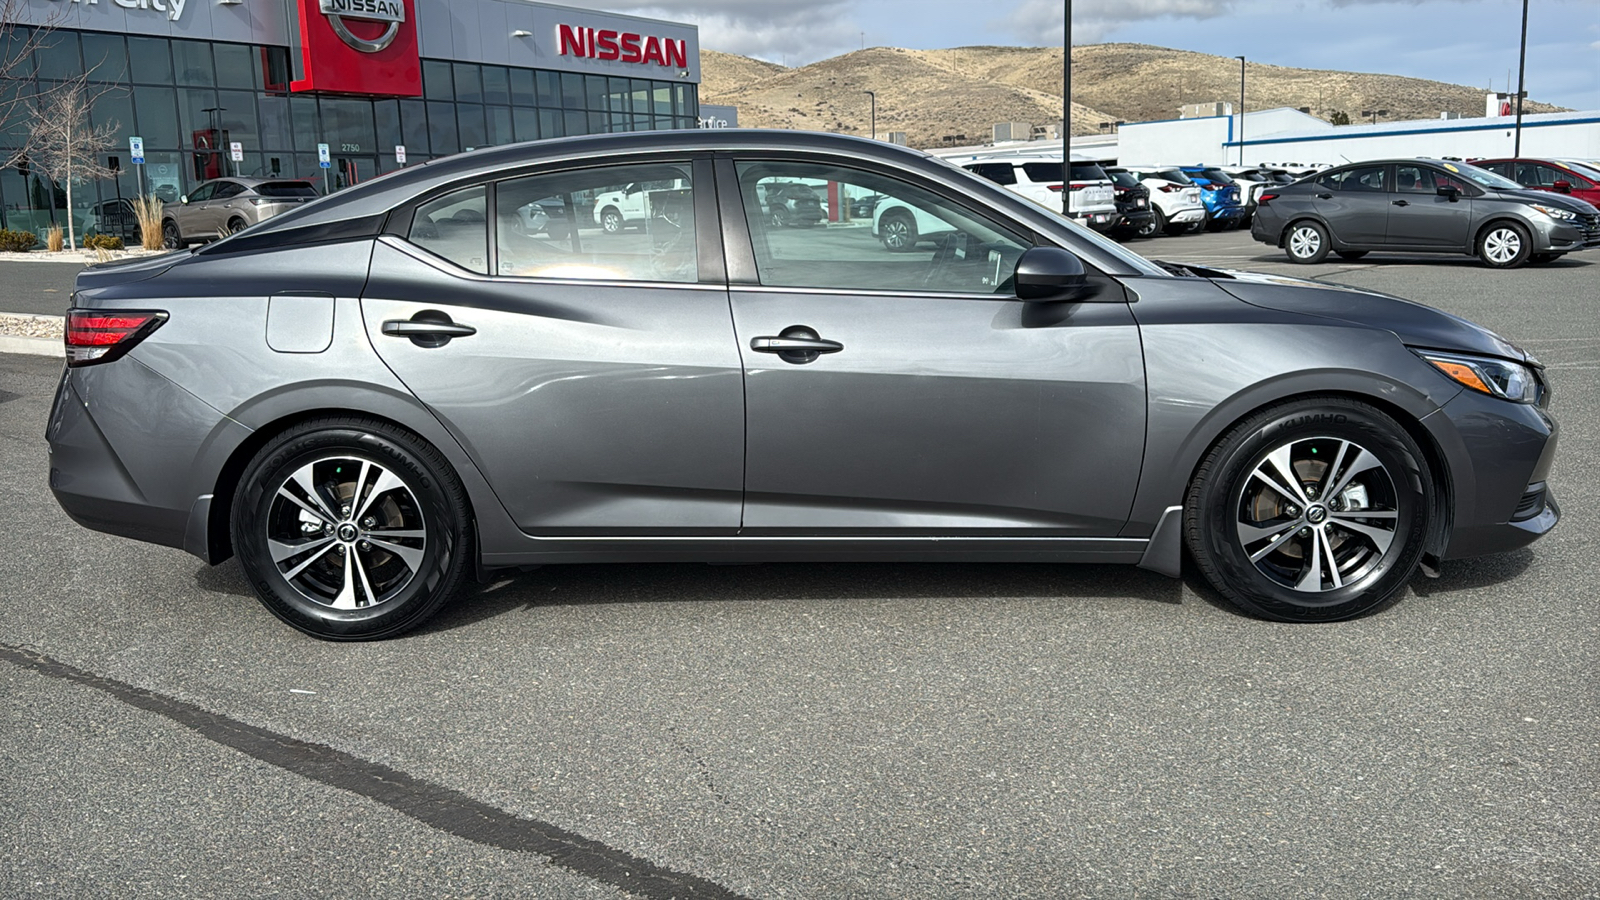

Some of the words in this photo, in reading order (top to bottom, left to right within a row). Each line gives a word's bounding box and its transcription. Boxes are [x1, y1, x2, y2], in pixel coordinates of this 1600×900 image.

[332, 0, 399, 16] NISSAN
[557, 24, 687, 68] NISSAN
[342, 143, 360, 152] 2750
[1278, 413, 1349, 431] KUMHO
[377, 442, 432, 490] KUMHO
